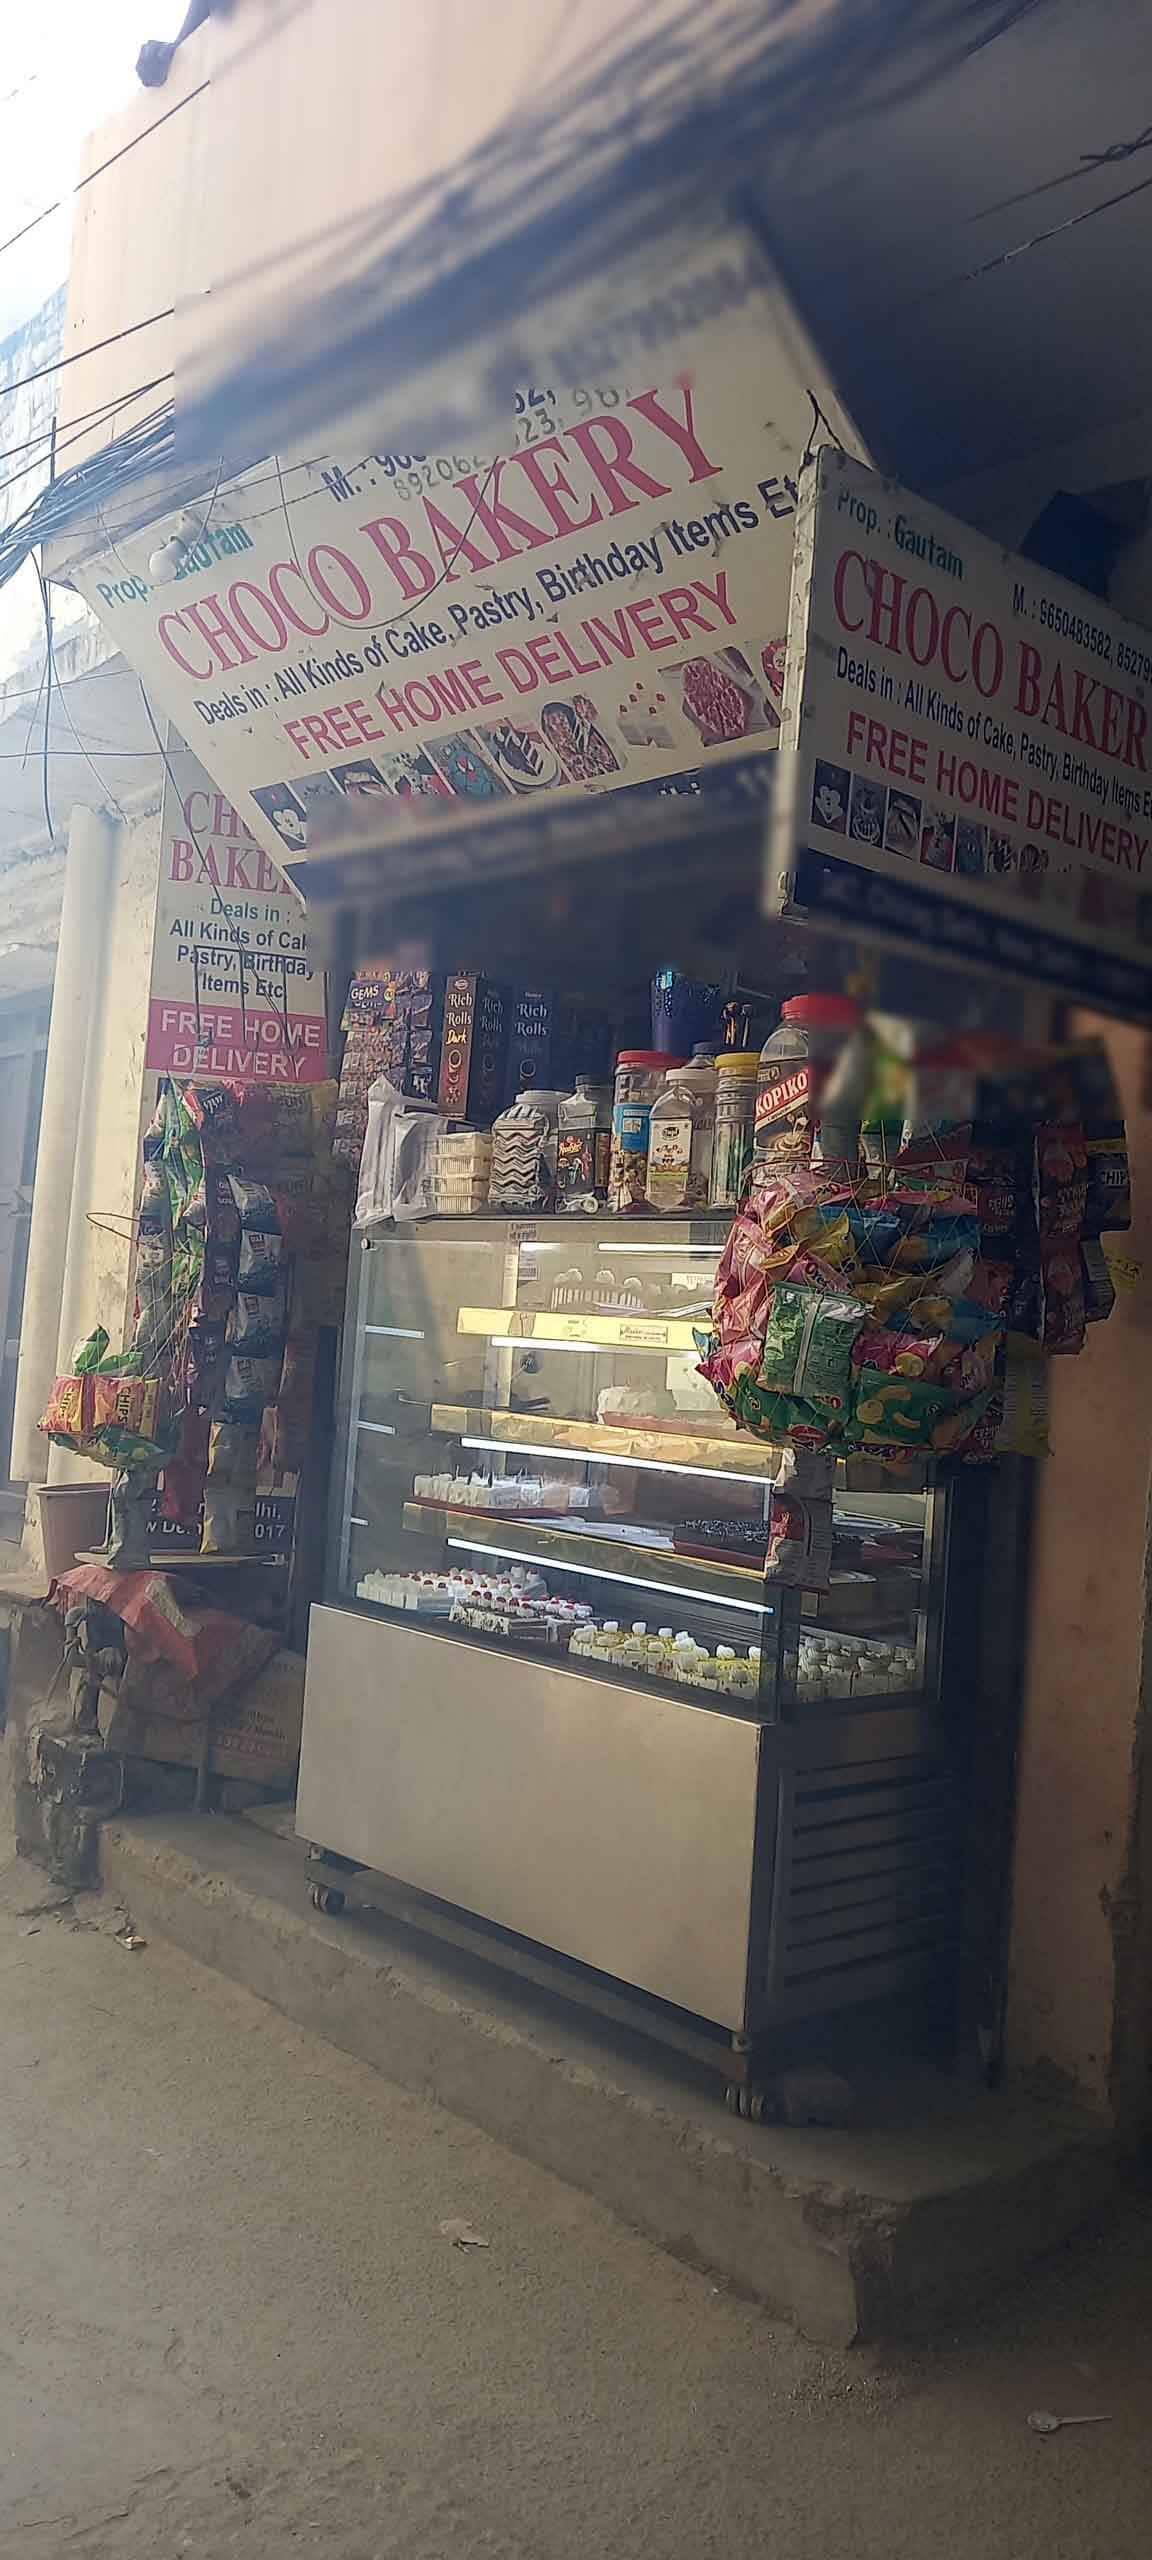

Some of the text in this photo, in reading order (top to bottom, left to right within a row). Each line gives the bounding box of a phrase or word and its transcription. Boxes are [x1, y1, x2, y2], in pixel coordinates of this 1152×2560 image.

[157, 544, 372, 681] CHOCO
[358, 368, 723, 602] BAKERY
[837, 489, 882, 535] Prop.
[893, 513, 965, 581] Gautam
[193, 686, 251, 726] Deals
[249, 683, 271, 710] in
[273, 662, 305, 700] All
[299, 649, 365, 690] Kinds
[363, 634, 390, 668] of
[384, 619, 454, 659] Cake,
[448, 585, 545, 638] Pastry,
[535, 536, 665, 603] Birthday
[663, 500, 760, 556] Items
[757, 474, 800, 520] Et
[833, 549, 1005, 699] CHOCO
[282, 571, 738, 760] FREE HOME DELIVERY
[836, 645, 877, 699] Deals
[880, 668, 894, 702] in
[904, 678, 923, 715] All
[926, 691, 964, 734] Kinds
[967, 710, 981, 740] of
[982, 716, 1017, 762] Cake,
[1019, 733, 1060, 784] Pastry,
[1062, 752, 1111, 803] Birthday
[1112, 774, 1142, 814] Items
[846, 710, 1150, 874] FREE HOME DELIVERY
[168, 838, 293, 896] BAKE
[210, 897, 259, 920] Deals
[264, 903, 280, 923] in
[169, 918, 194, 938] All
[200, 921, 250, 945] Kinds
[255, 929, 274, 947] of
[177, 944, 237, 972] Pastry,
[202, 972, 250, 995] Items
[351, 984, 379, 1000] GEMS
[448, 992, 473, 1009] Rich
[161, 1008, 321, 1048] FREE HOME
[446, 1011, 472, 1027] Rolls
[514, 1022, 547, 1037] Rolls
[517, 1003, 549, 1018] Rich
[445, 1029, 468, 1046] Dark
[172, 1043, 307, 1081] DELIVERY
[755, 1071, 808, 1118] KOPIKO
[118, 1385, 131, 1425] CHIPS
